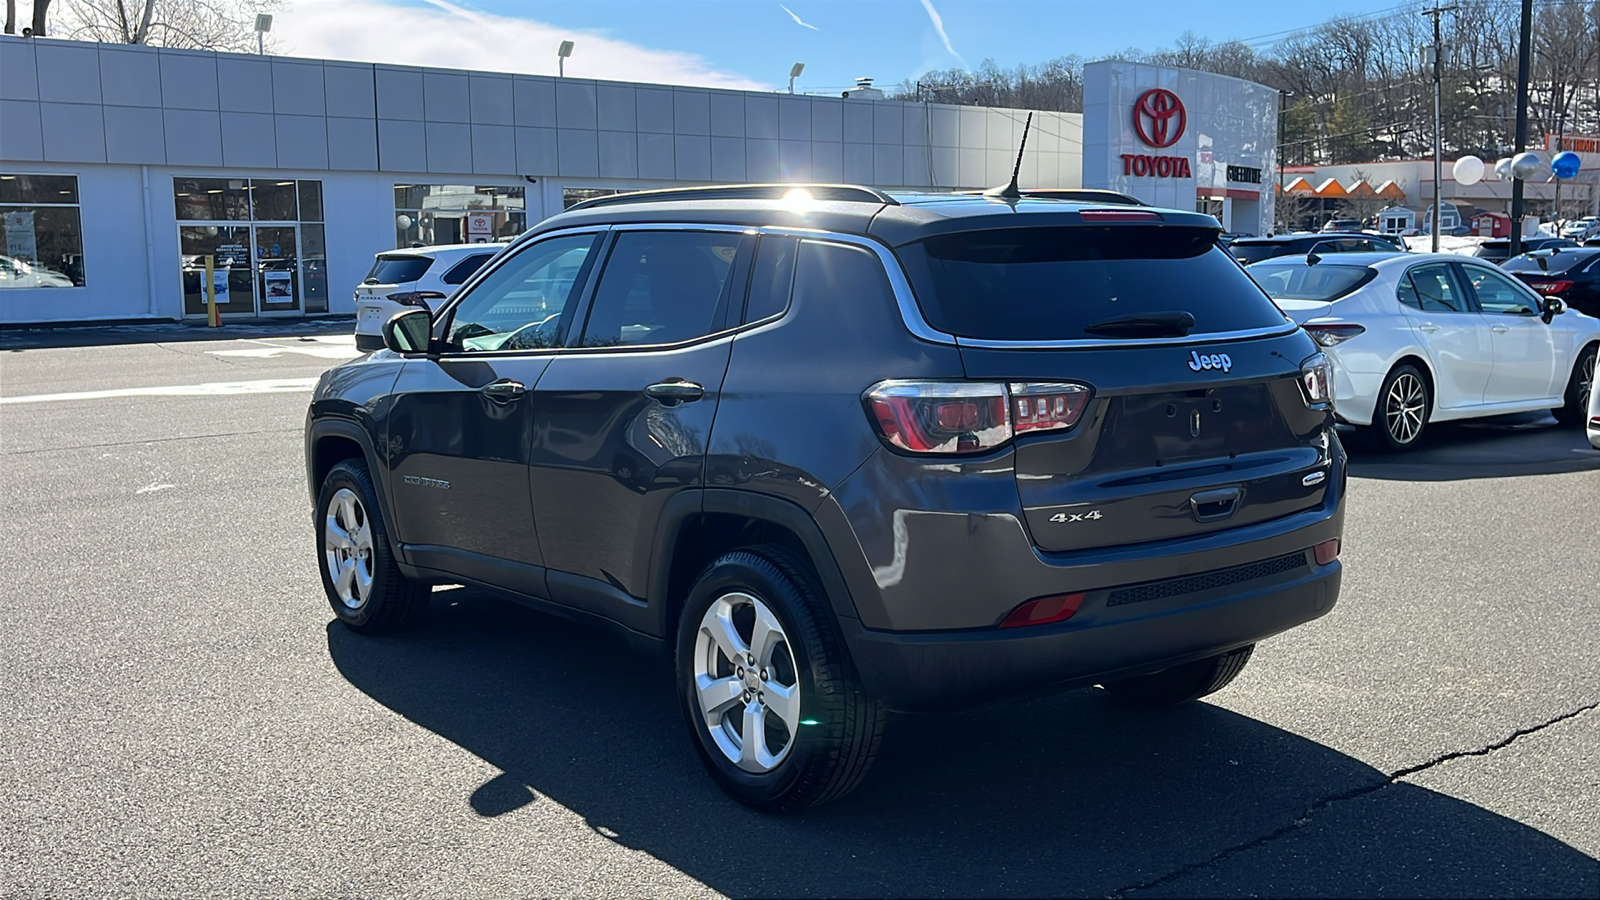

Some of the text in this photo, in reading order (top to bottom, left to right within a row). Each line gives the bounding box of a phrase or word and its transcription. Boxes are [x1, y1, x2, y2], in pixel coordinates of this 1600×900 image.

[1121, 154, 1192, 178] TOYOTA
[1188, 350, 1232, 372] Jeep
[1049, 510, 1103, 523] 4x4
